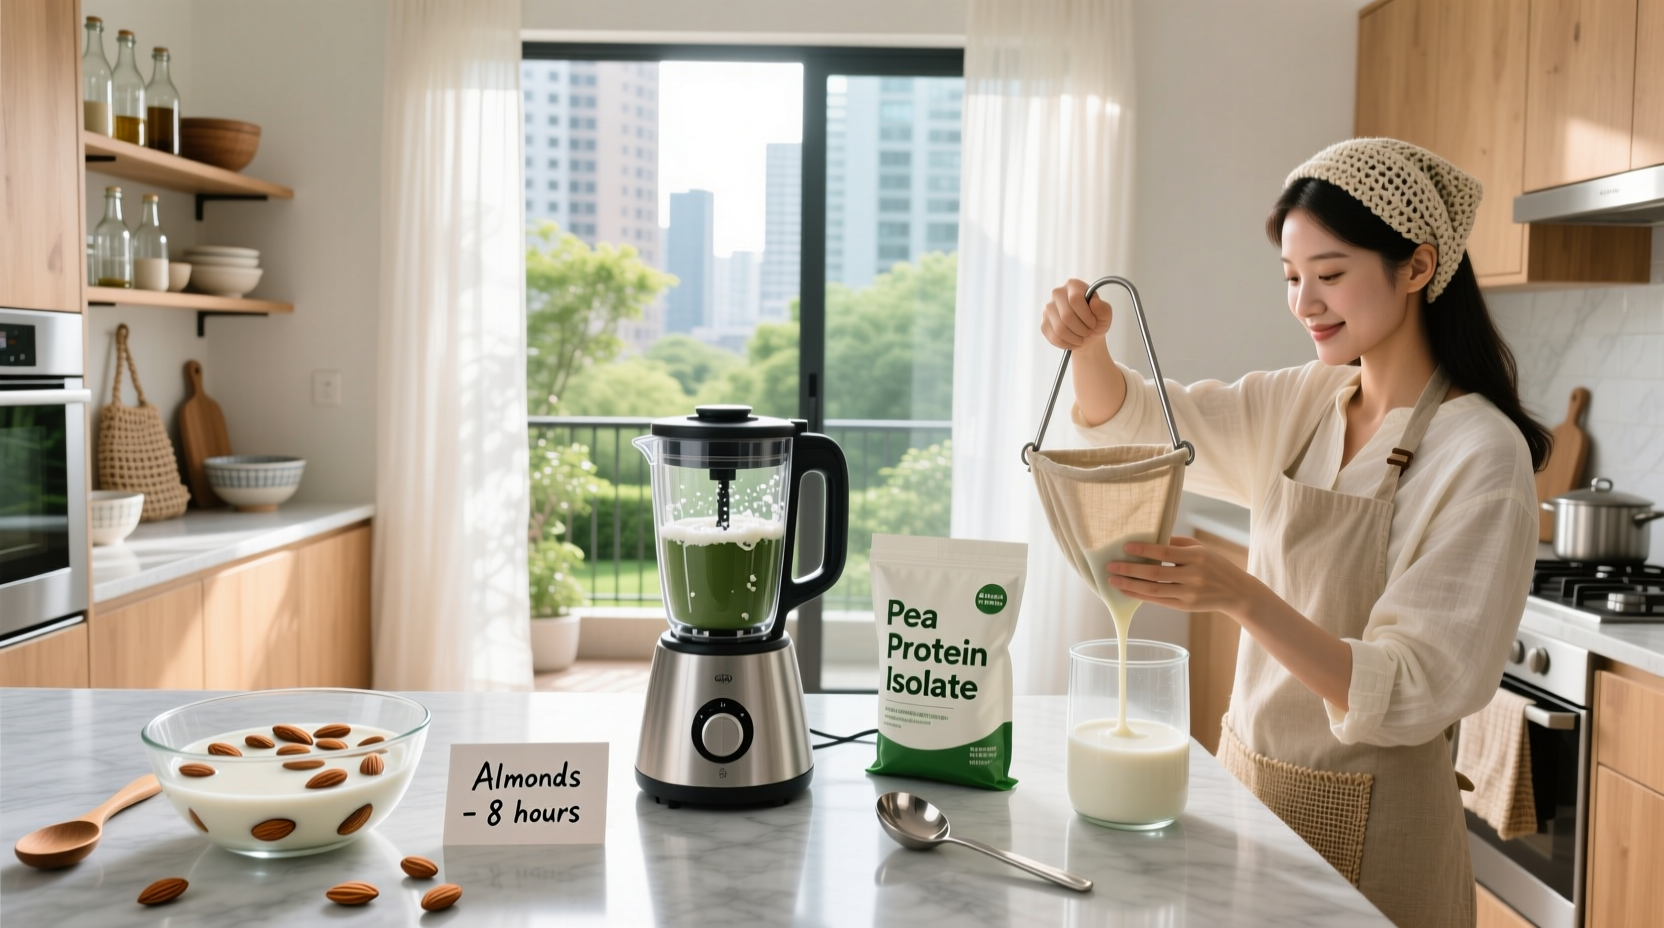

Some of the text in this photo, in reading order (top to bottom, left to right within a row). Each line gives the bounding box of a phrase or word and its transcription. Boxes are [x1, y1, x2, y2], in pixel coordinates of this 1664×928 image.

[887, 599, 938, 629] Pea
[887, 632, 988, 667] Protein
[886, 665, 978, 700] Isolate
[471, 760, 581, 791] Almonds
[486, 799, 503, 827] 8
[513, 799, 581, 824] hours
